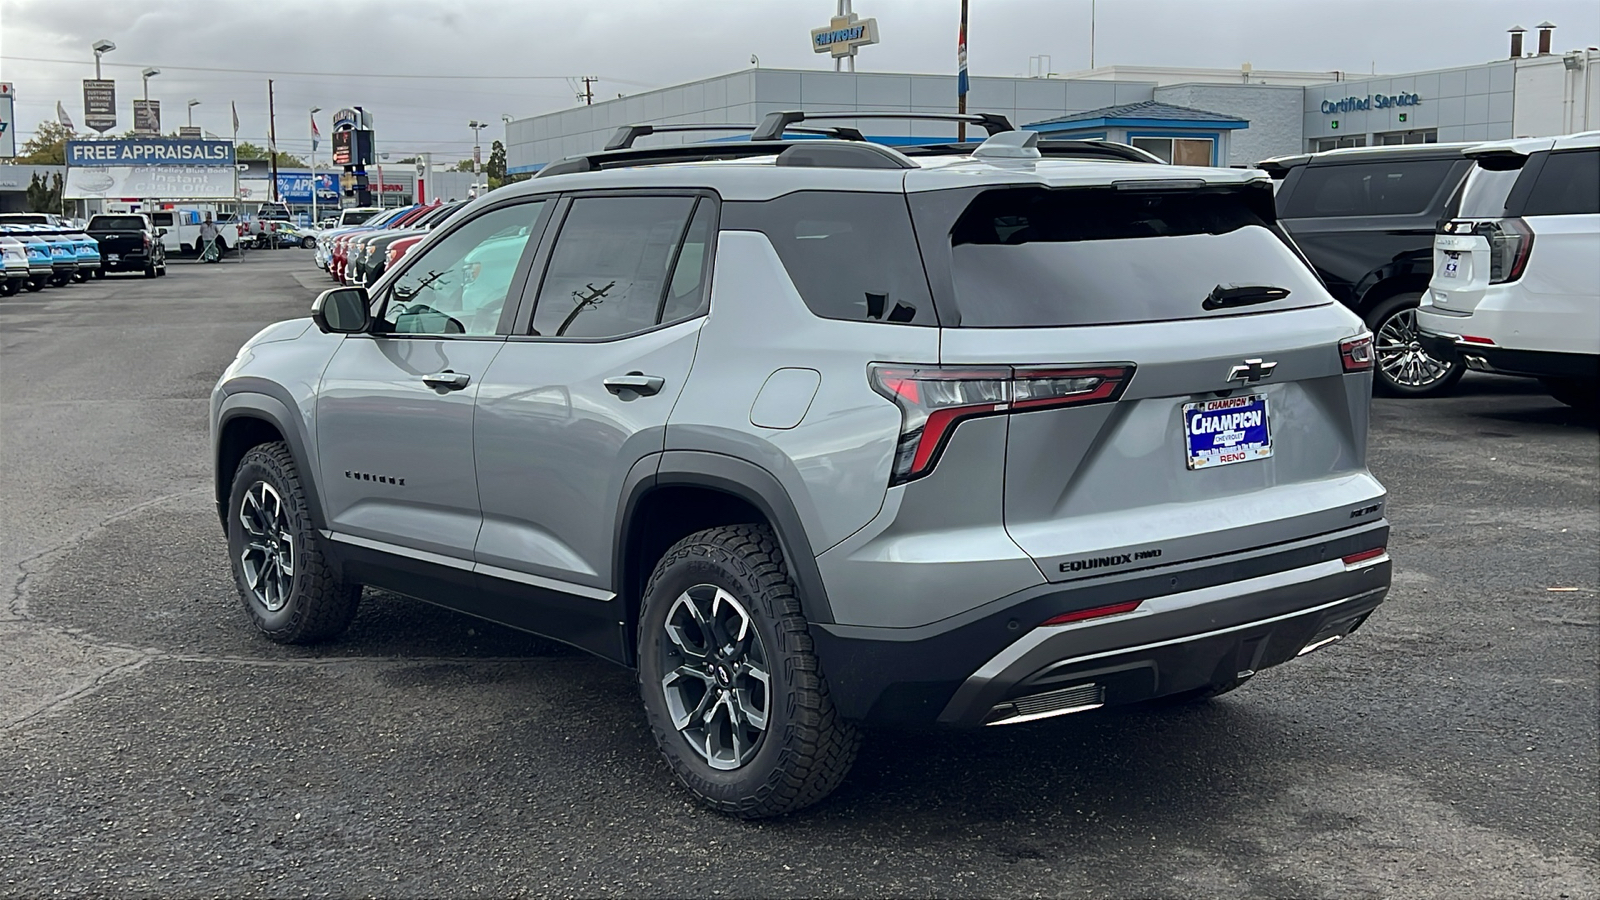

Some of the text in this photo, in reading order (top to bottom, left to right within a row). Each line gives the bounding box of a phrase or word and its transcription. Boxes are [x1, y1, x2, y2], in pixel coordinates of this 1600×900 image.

[815, 26, 864, 46] CHEVROLET
[1321, 91, 1420, 114] Certified Service
[73, 145, 230, 160] FREE APPRAISALS!
[152, 173, 209, 183] Instant
[293, 179, 314, 191] APR
[135, 183, 223, 192] Cash Offer
[1207, 397, 1247, 411] CHAMPION
[1191, 410, 1262, 435] CHAMPION
[1215, 432, 1243, 442] CHEVROLET
[1220, 452, 1246, 463] RENO
[1059, 553, 1132, 573] EQUINOX
